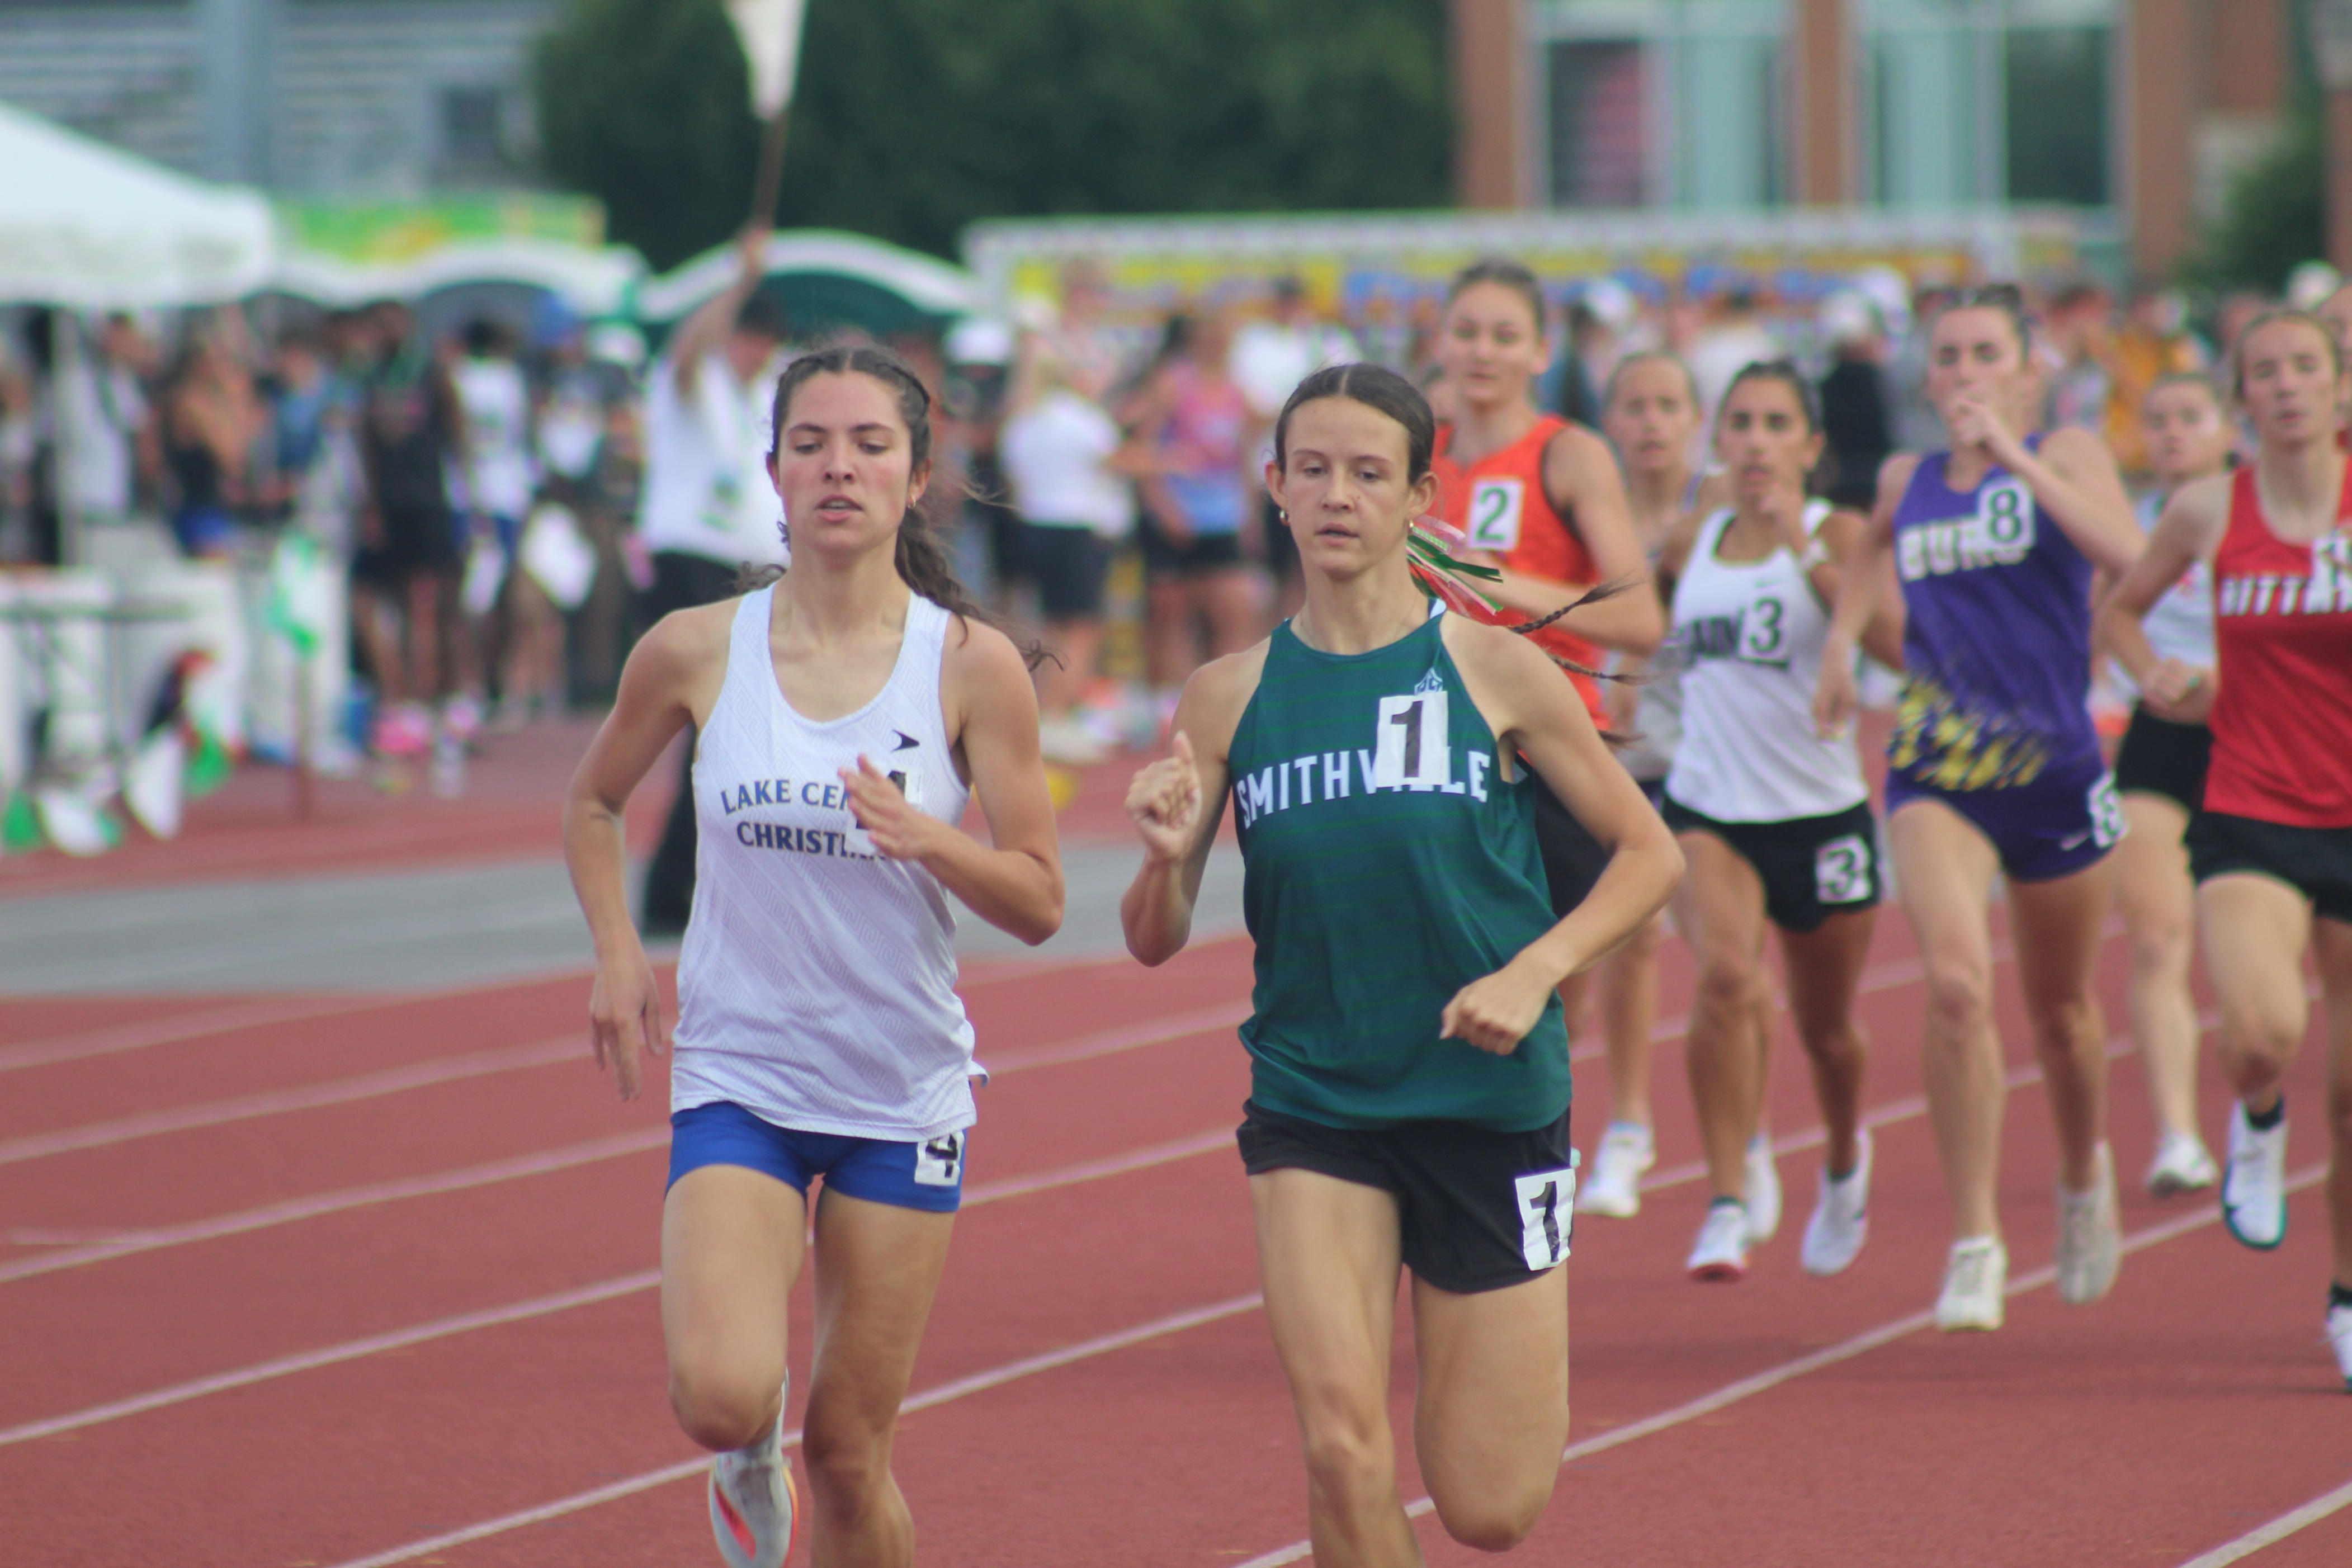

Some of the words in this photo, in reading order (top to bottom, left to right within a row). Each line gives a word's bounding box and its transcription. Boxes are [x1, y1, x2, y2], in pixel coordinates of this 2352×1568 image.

[1475, 487, 1508, 542] 2
[1988, 488, 2023, 544] 8
[1747, 596, 1783, 653] 3
[1391, 700, 1424, 778] 1
[720, 778, 791, 815] LAKE
[1236, 745, 1491, 830] SMITHVLE
[736, 820, 886, 861] CHRISTI
[1825, 847, 1857, 895] 3
[925, 1133, 958, 1178] 4
[1529, 1180, 1561, 1263] 1
